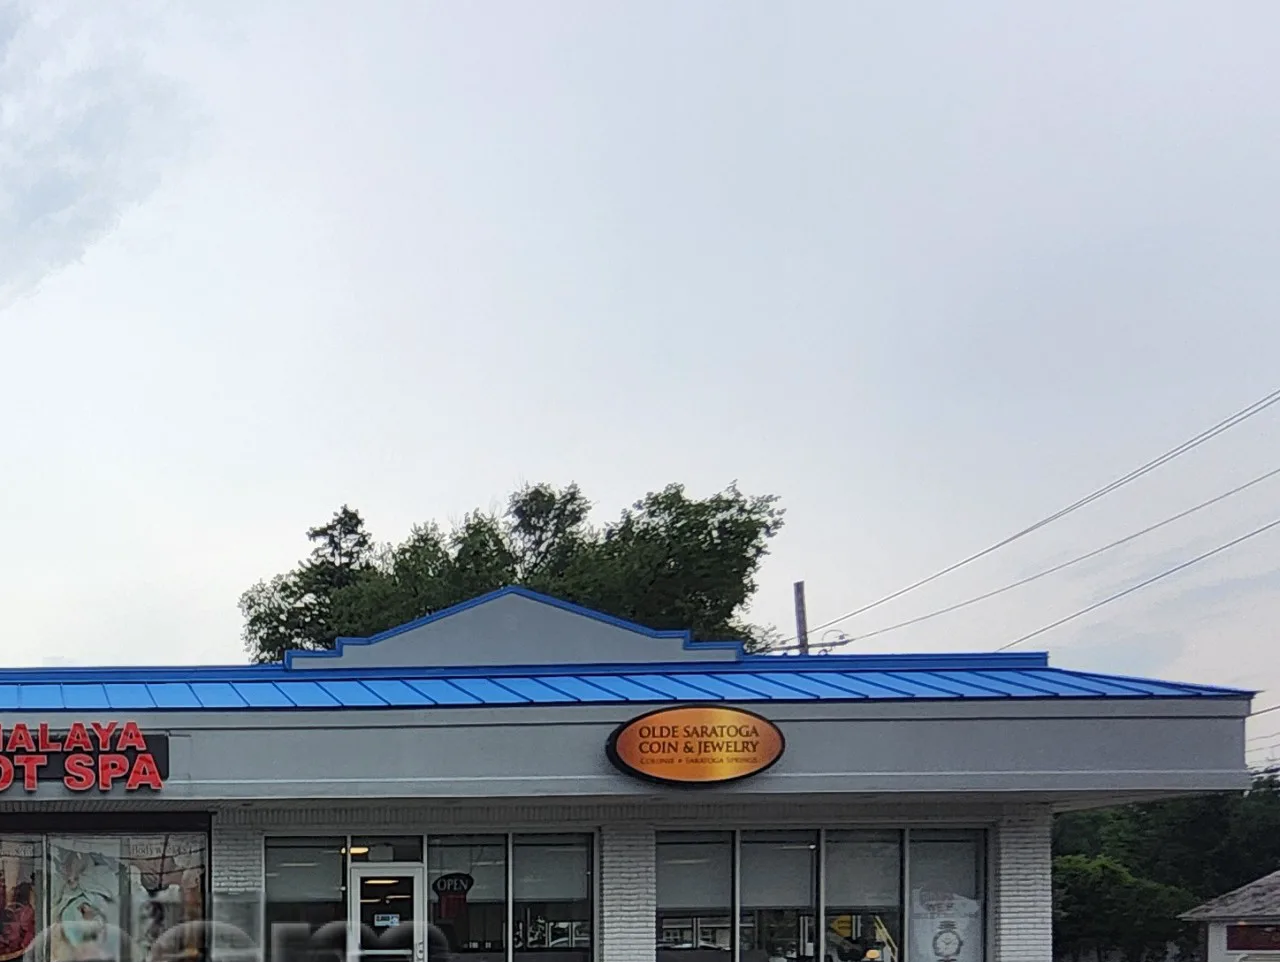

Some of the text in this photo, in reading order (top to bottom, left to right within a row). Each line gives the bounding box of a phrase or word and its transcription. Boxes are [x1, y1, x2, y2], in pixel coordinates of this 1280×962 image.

[638, 725, 759, 738] OLDE SARATOGA
[638, 740, 759, 755] COIN & JEWELRY
[63, 753, 163, 791] SPA
[437, 878, 469, 891] OPEN
